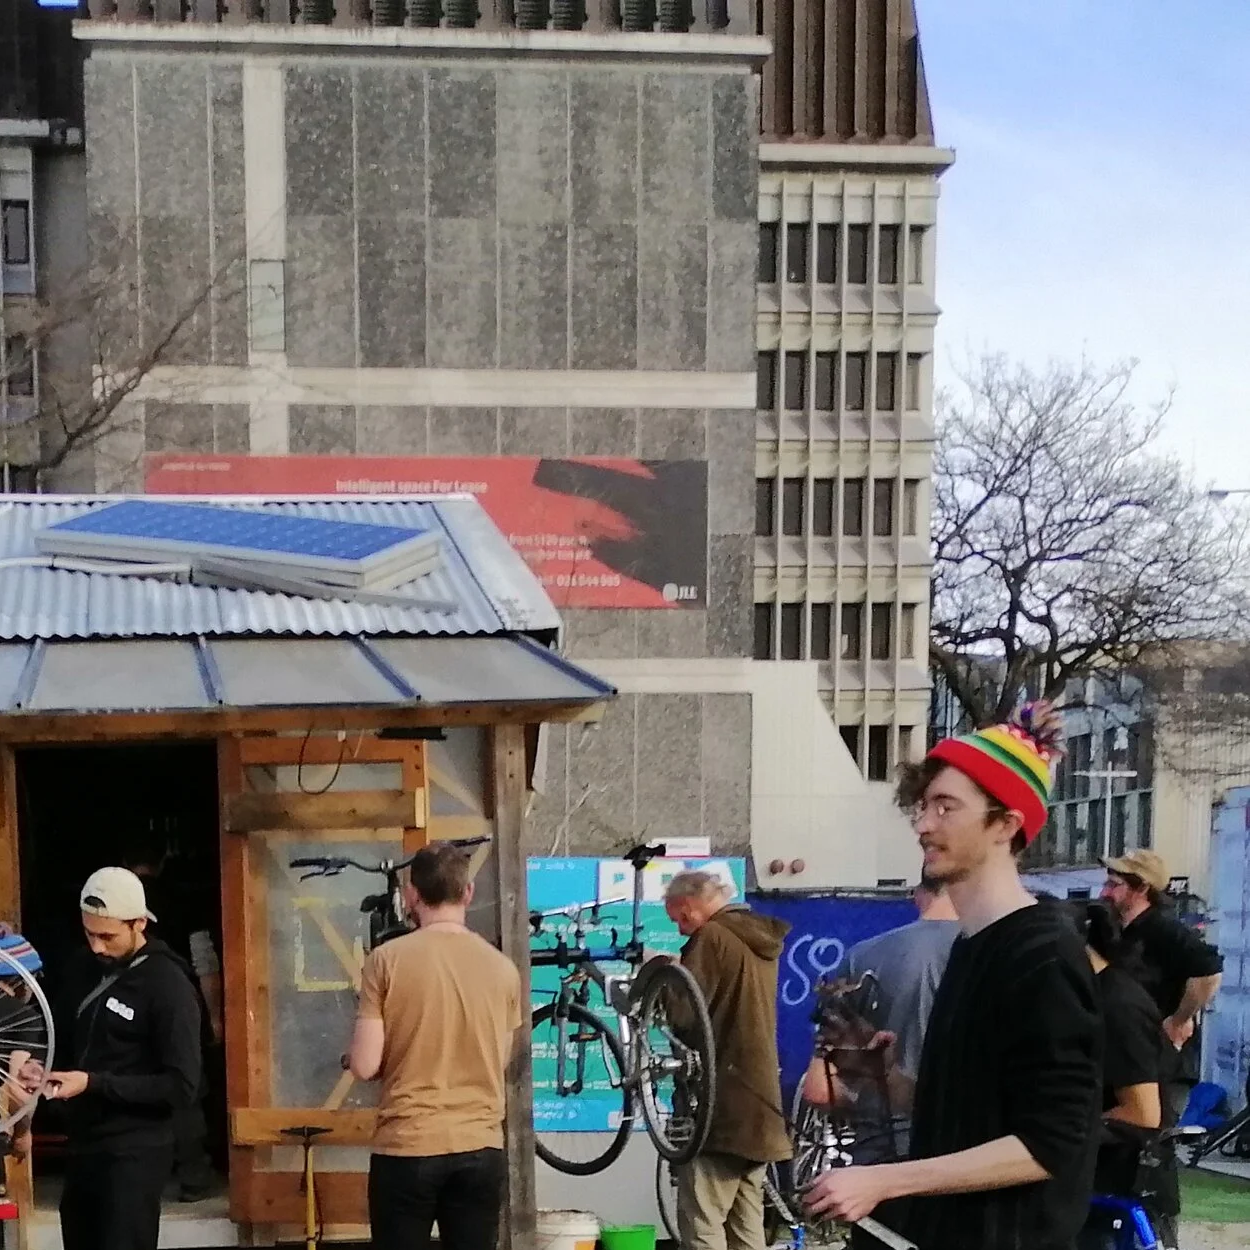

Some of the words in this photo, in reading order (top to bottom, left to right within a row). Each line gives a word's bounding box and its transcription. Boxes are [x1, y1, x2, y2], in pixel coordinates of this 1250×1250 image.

[336, 478, 395, 495] Intelligent
[397, 481, 432, 495] space
[433, 479, 453, 493] For
[454, 479, 488, 493] Lease
